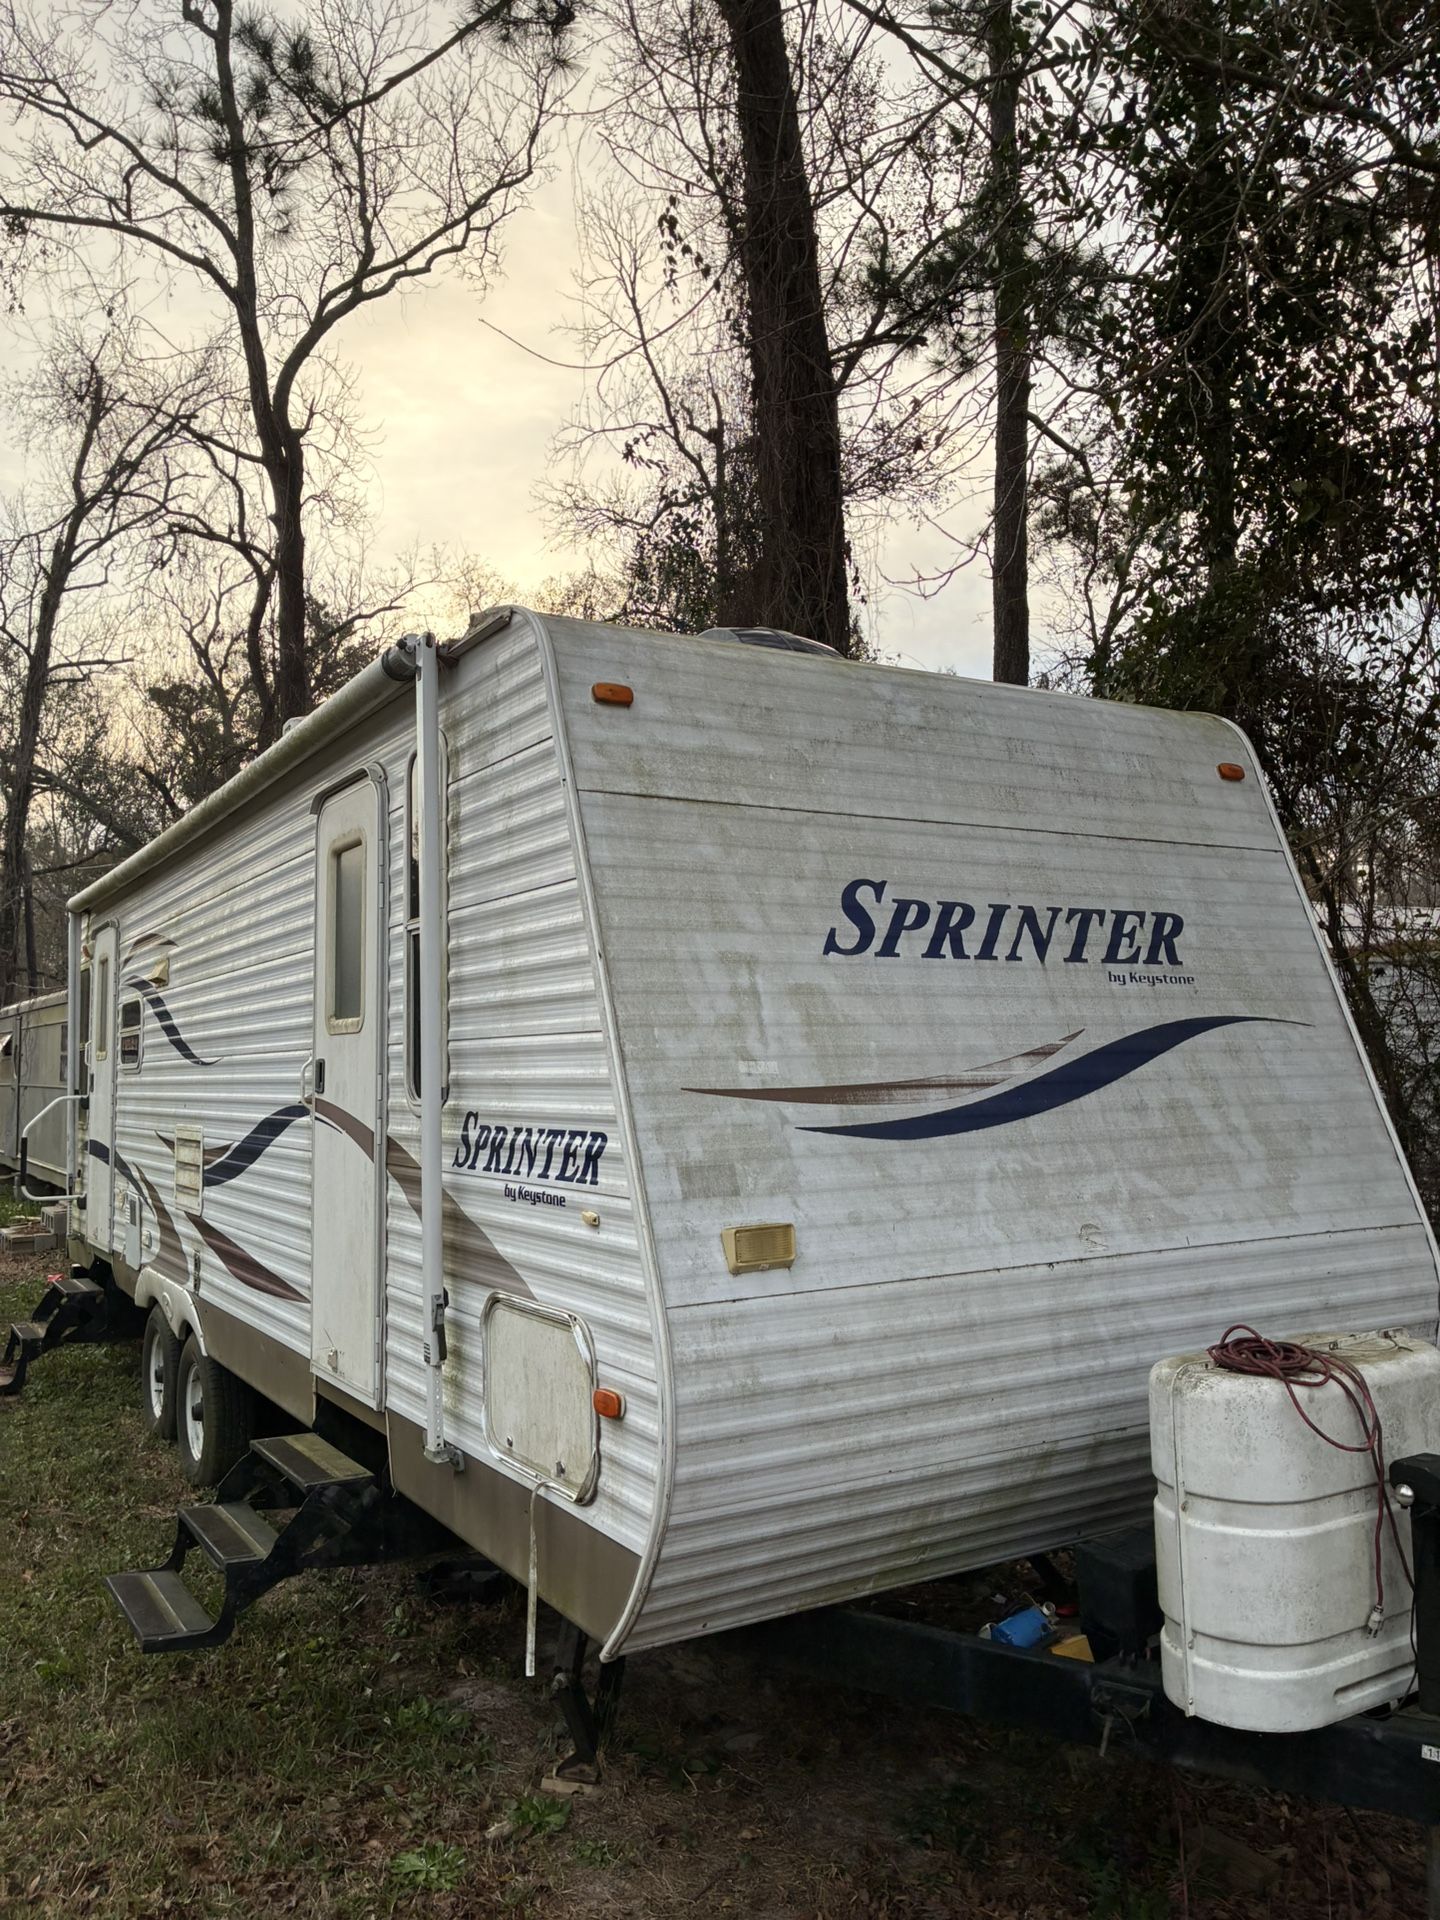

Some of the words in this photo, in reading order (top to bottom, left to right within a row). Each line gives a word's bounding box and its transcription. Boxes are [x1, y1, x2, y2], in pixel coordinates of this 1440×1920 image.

[823, 878, 1185, 965] SPRINTER
[1108, 970, 1126, 986] by
[1129, 971, 1195, 986] Keystone
[452, 1111, 608, 1186] SPRINTER
[504, 1183, 517, 1202] by
[518, 1185, 566, 1208] Keystone
